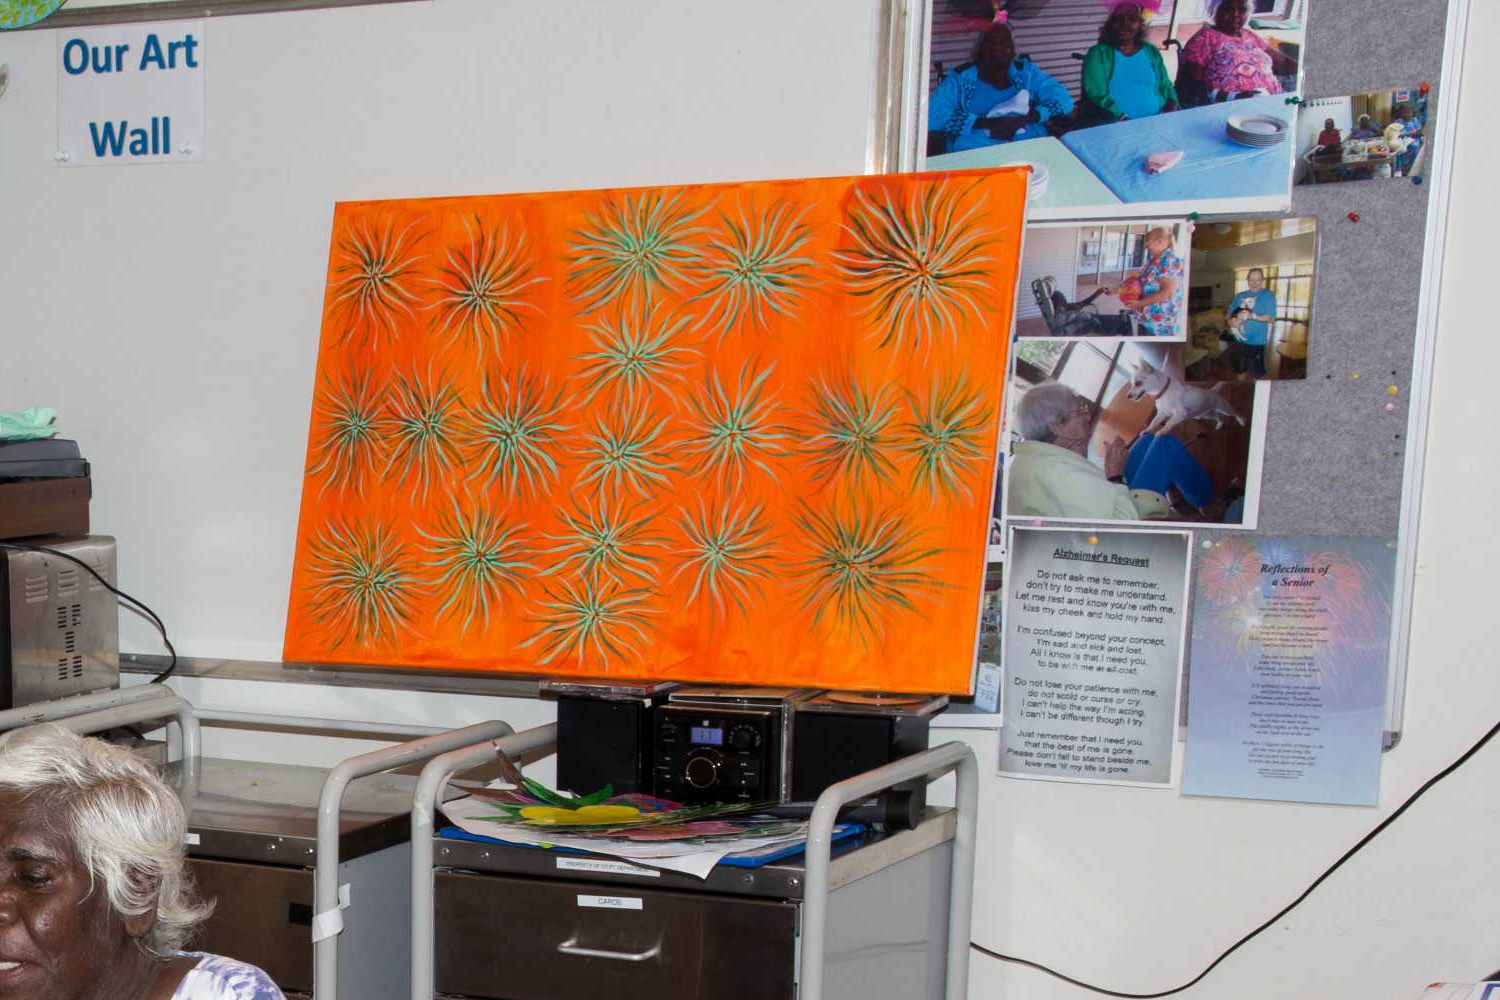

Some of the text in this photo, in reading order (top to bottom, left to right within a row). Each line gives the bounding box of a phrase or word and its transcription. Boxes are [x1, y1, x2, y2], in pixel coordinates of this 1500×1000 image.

[63, 34, 198, 75] Our Art
[89, 116, 170, 157] Wall
[1054, 549, 1149, 567] Alzheimer's Request
[1037, 569, 1050, 579] Do
[1052, 571, 1067, 580] not
[1069, 573, 1085, 582] ask
[1103, 575, 1111, 584] to
[1260, 564, 1332, 576] Reflections of
[1026, 580, 1049, 590] don't
[1050, 582, 1061, 594] try
[1064, 584, 1073, 592] to
[1075, 586, 1099, 595] make
[1280, 578, 1314, 587] Senior
[1016, 591, 1029, 600] Let
[1048, 595, 1065, 603] rest
[1067, 596, 1084, 605] and
[1086, 597, 1108, 607] know
[1111, 600, 1137, 612] you're
[1140, 602, 1157, 611] with
[1023, 603, 1040, 612] kiss
[1043, 607, 1056, 616] my
[1059, 606, 1084, 616] cheek
[1087, 609, 1103, 618] and
[1106, 610, 1123, 620] hold
[1126, 614, 1140, 623] my
[1017, 625, 1030, 634] I'm
[1033, 628, 1073, 638] confused
[1075, 630, 1106, 643] beyond
[1108, 636, 1128, 645] your
[1049, 650, 1071, 659] know
[1084, 653, 1100, 661] that
[1106, 656, 1127, 664] need
[1014, 677, 1027, 686] Do
[1030, 679, 1043, 687] not
[1045, 680, 1062, 689] lose
[1064, 683, 1082, 693] your
[1084, 684, 1120, 696] patience
[1123, 687, 1139, 696] with
[1028, 689, 1038, 697] do
[1057, 692, 1078, 700] scold
[1070, 702, 1082, 711] the
[1084, 706, 1101, 715] way
[1048, 711, 1059, 720] be
[1061, 712, 1094, 723] different
[1096, 715, 1125, 727] though
[1017, 728, 1035, 737] Just
[1037, 732, 1078, 741] remember
[1081, 734, 1097, 743] that
[1104, 737, 1125, 745] need
[1025, 739, 1040, 748] that
[1043, 741, 1055, 749] the
[1057, 742, 1075, 751] best
[1078, 744, 1085, 752] of
[1083, 754, 1106, 763] stand
